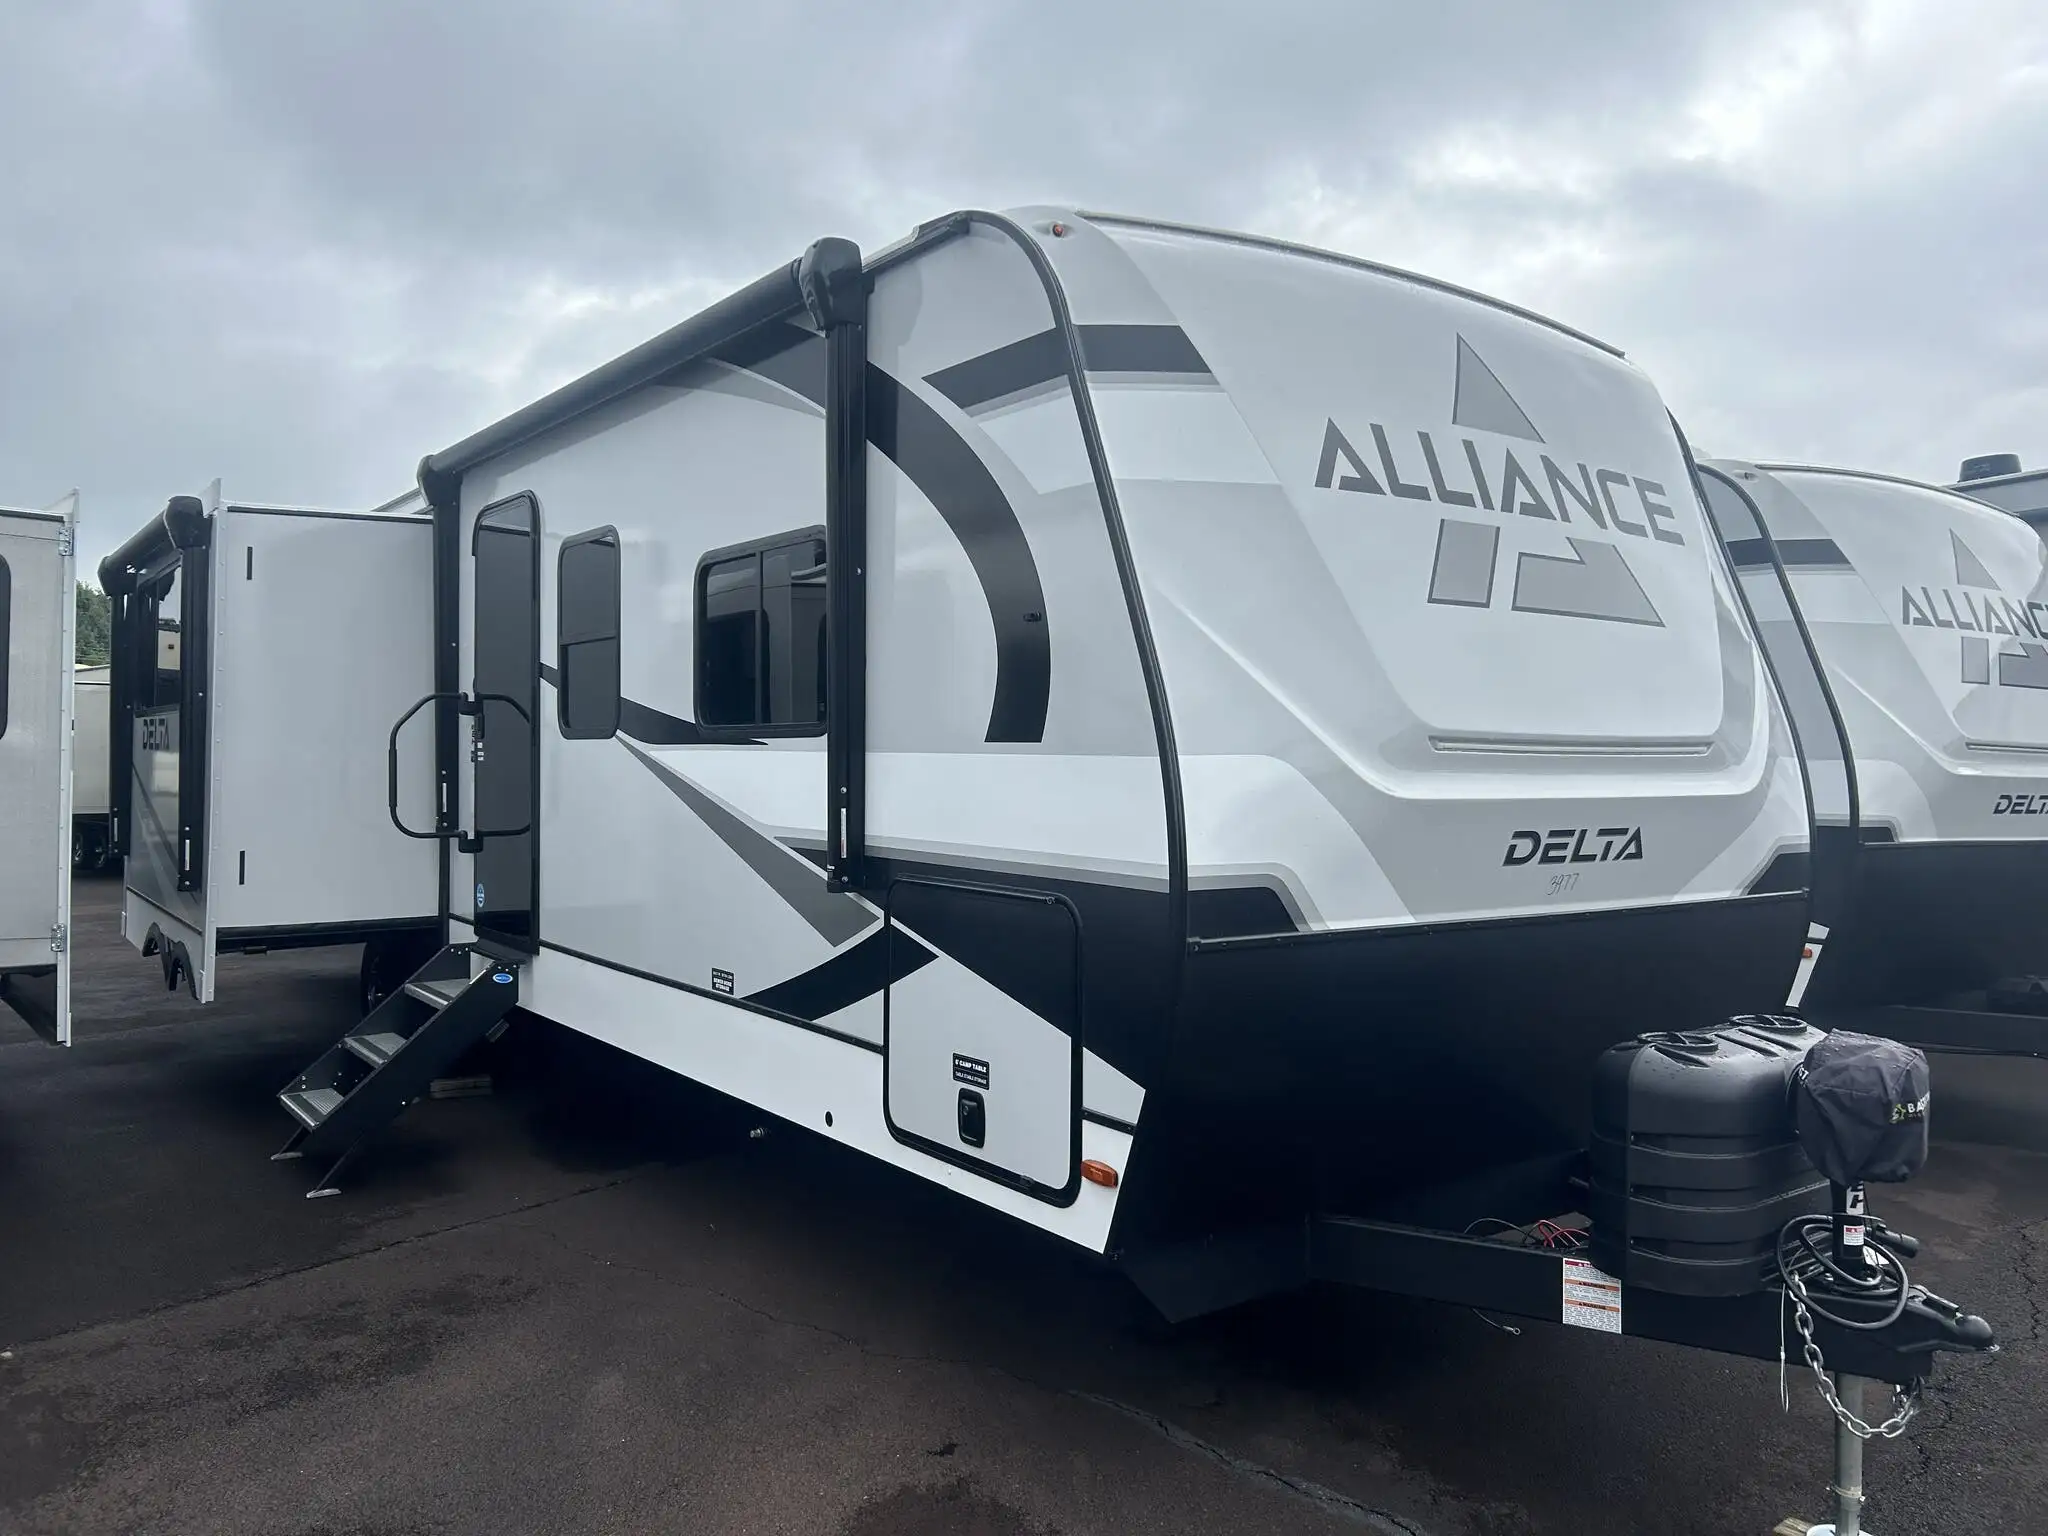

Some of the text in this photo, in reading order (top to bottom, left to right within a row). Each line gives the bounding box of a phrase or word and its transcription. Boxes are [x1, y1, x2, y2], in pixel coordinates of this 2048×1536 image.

[1314, 416, 1686, 546] ALLIANCE
[1902, 584, 2048, 640] ALLIANC
[142, 718, 170, 751] DELTA
[1993, 794, 2048, 815] DELT
[1502, 826, 1643, 867] DELTA
